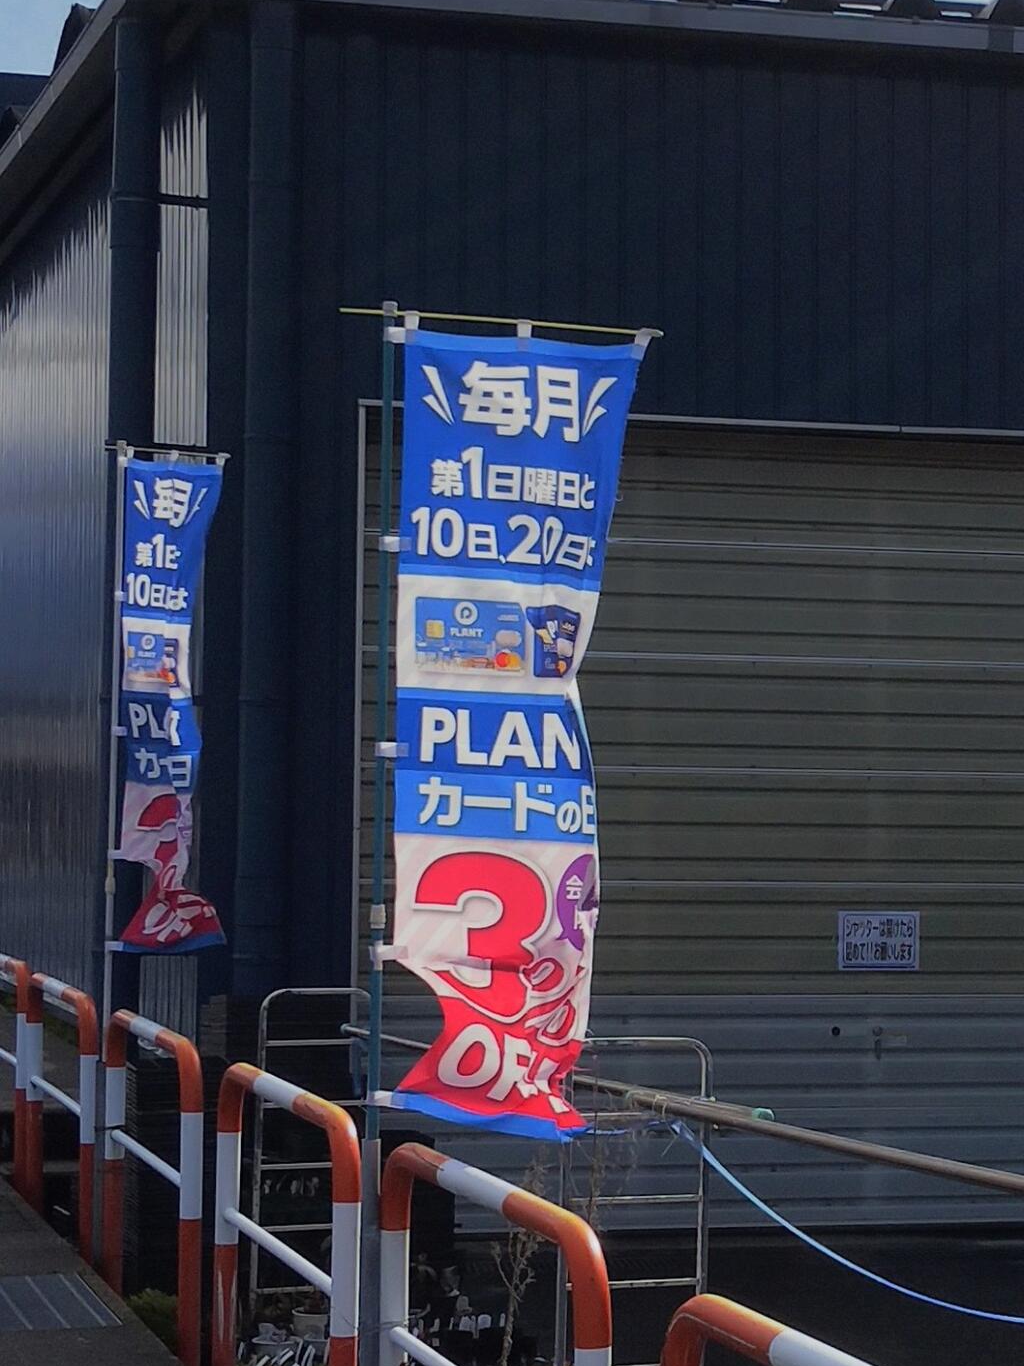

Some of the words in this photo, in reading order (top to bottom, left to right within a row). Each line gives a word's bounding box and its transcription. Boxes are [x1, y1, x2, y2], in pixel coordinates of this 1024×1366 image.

[457, 360, 581, 443] 毎月
[430, 446, 596, 510] 第1日曜日と
